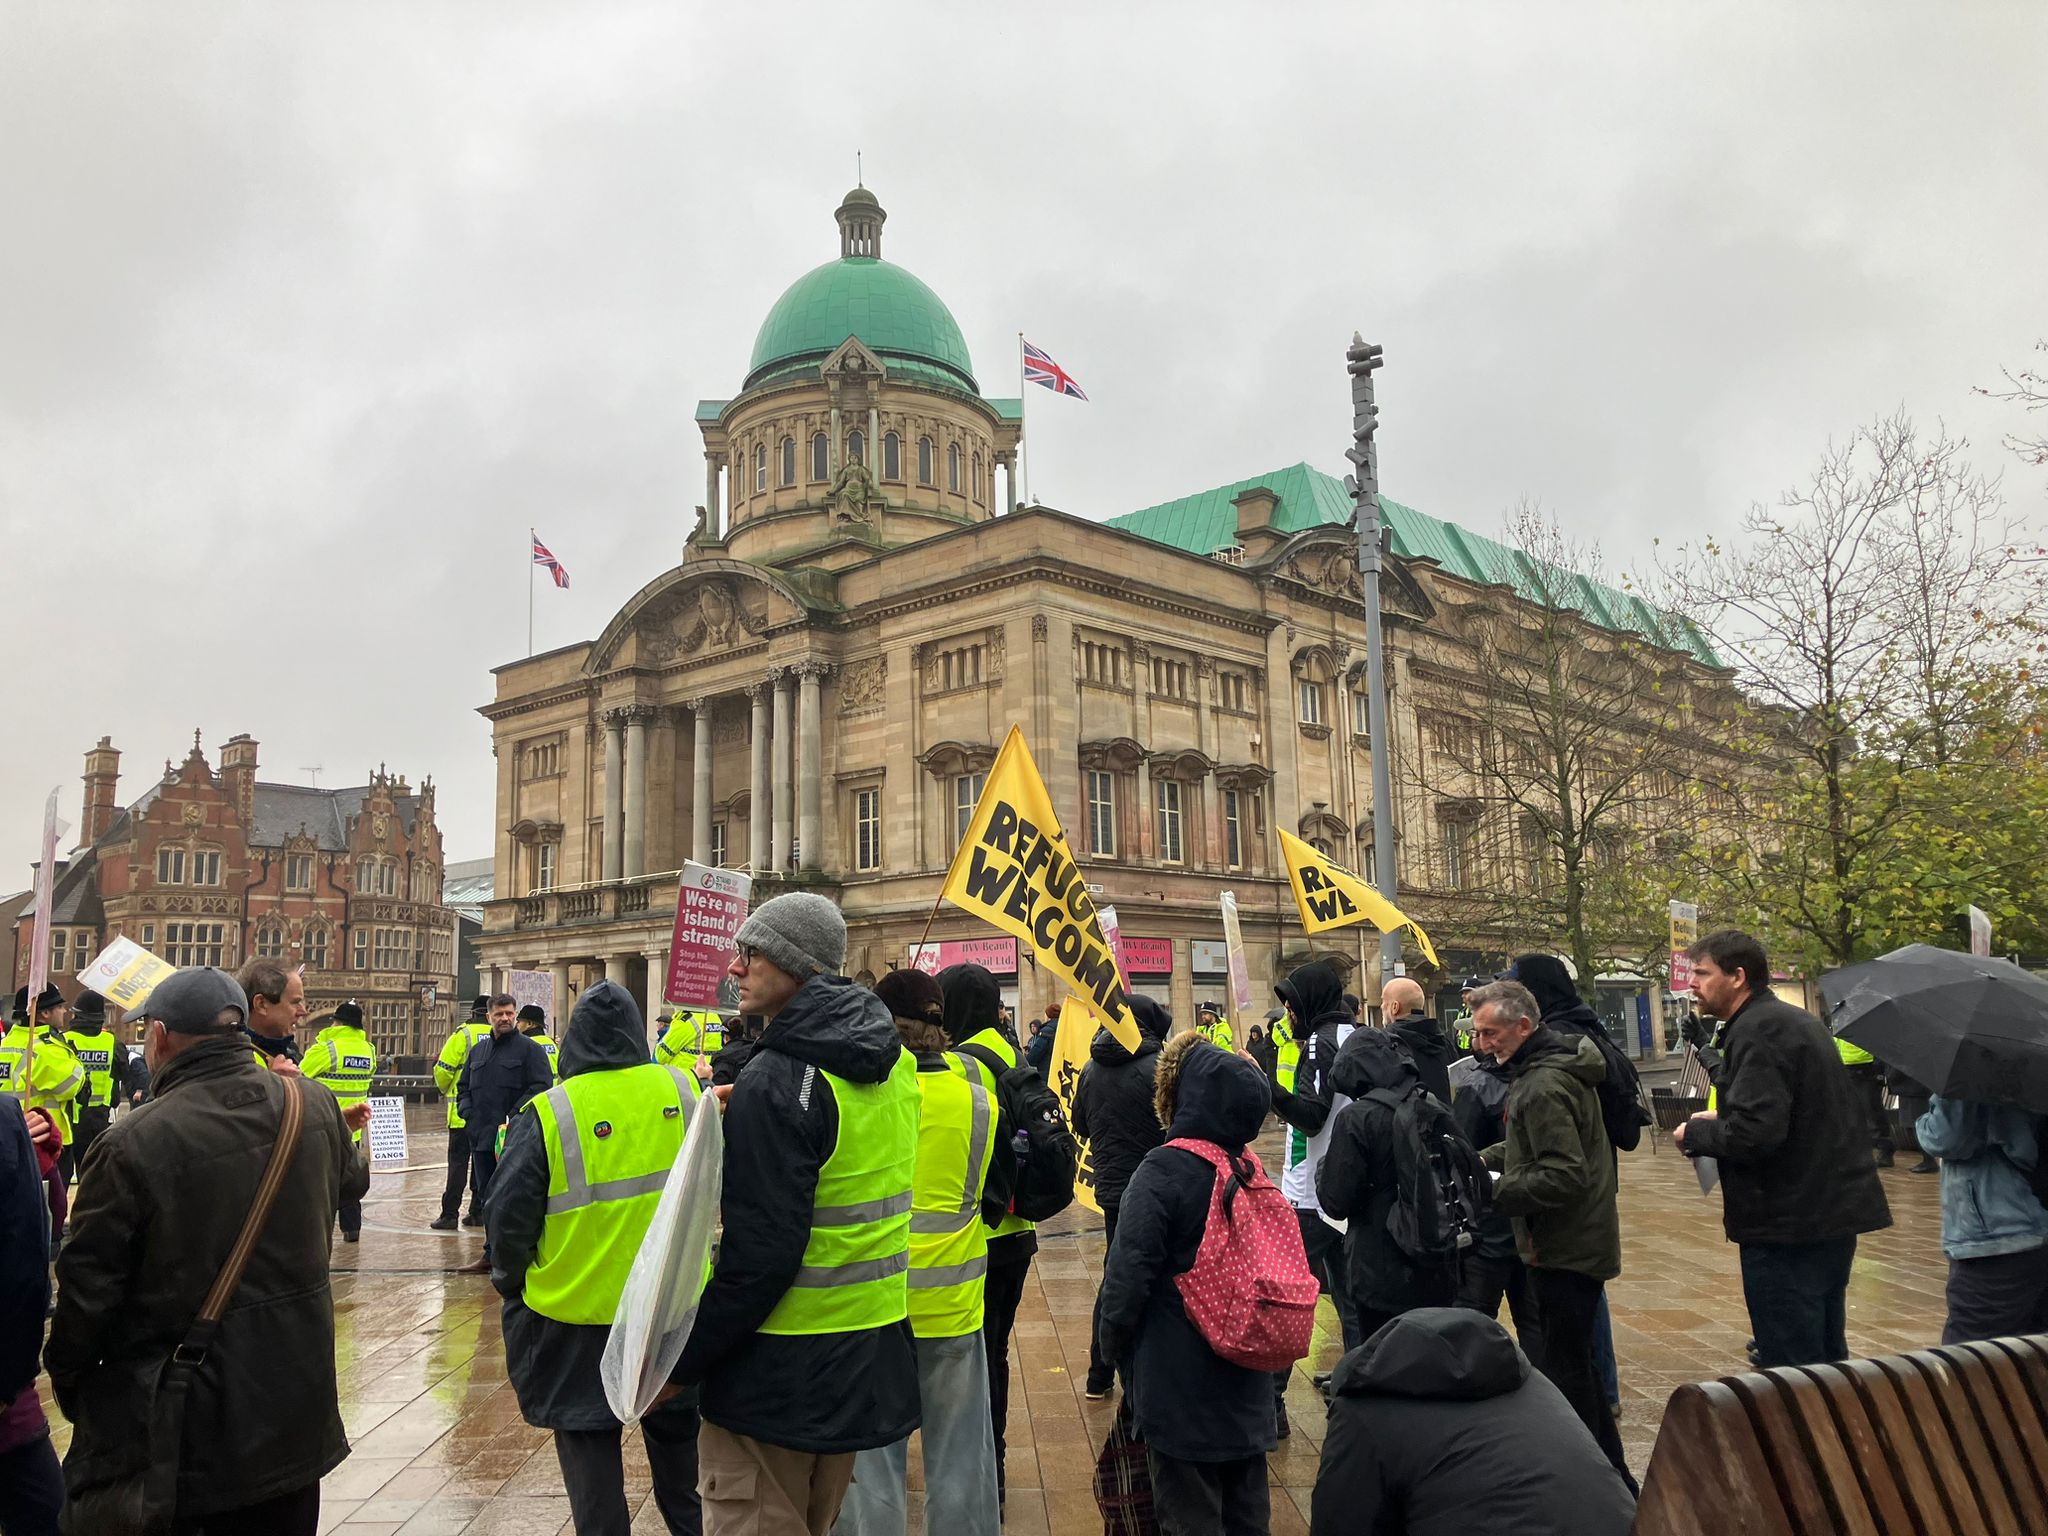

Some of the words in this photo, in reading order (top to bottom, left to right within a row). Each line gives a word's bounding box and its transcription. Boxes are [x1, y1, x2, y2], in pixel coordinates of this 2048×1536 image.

[685, 889, 723, 911] We're
[725, 901, 738, 915] no
[727, 918, 739, 938] of
[983, 940, 1014, 951] Beauty
[1141, 941, 1166, 951] Beauty
[679, 949, 696, 960] Stop
[697, 951, 708, 960] the
[976, 957, 993, 966] Nail
[996, 955, 1014, 965] Ltd.
[1125, 956, 1132, 965] &
[1135, 956, 1149, 965] Nail
[1152, 956, 1168, 965] Ltd.
[676, 970, 708, 982] Migrants
[708, 975, 719, 983] and
[1673, 968, 1686, 981] far
[674, 981, 705, 991] refugees
[673, 990, 705, 999] welcome
[78, 1051, 107, 1061] OLICE
[344, 1057, 370, 1068] POLICE
